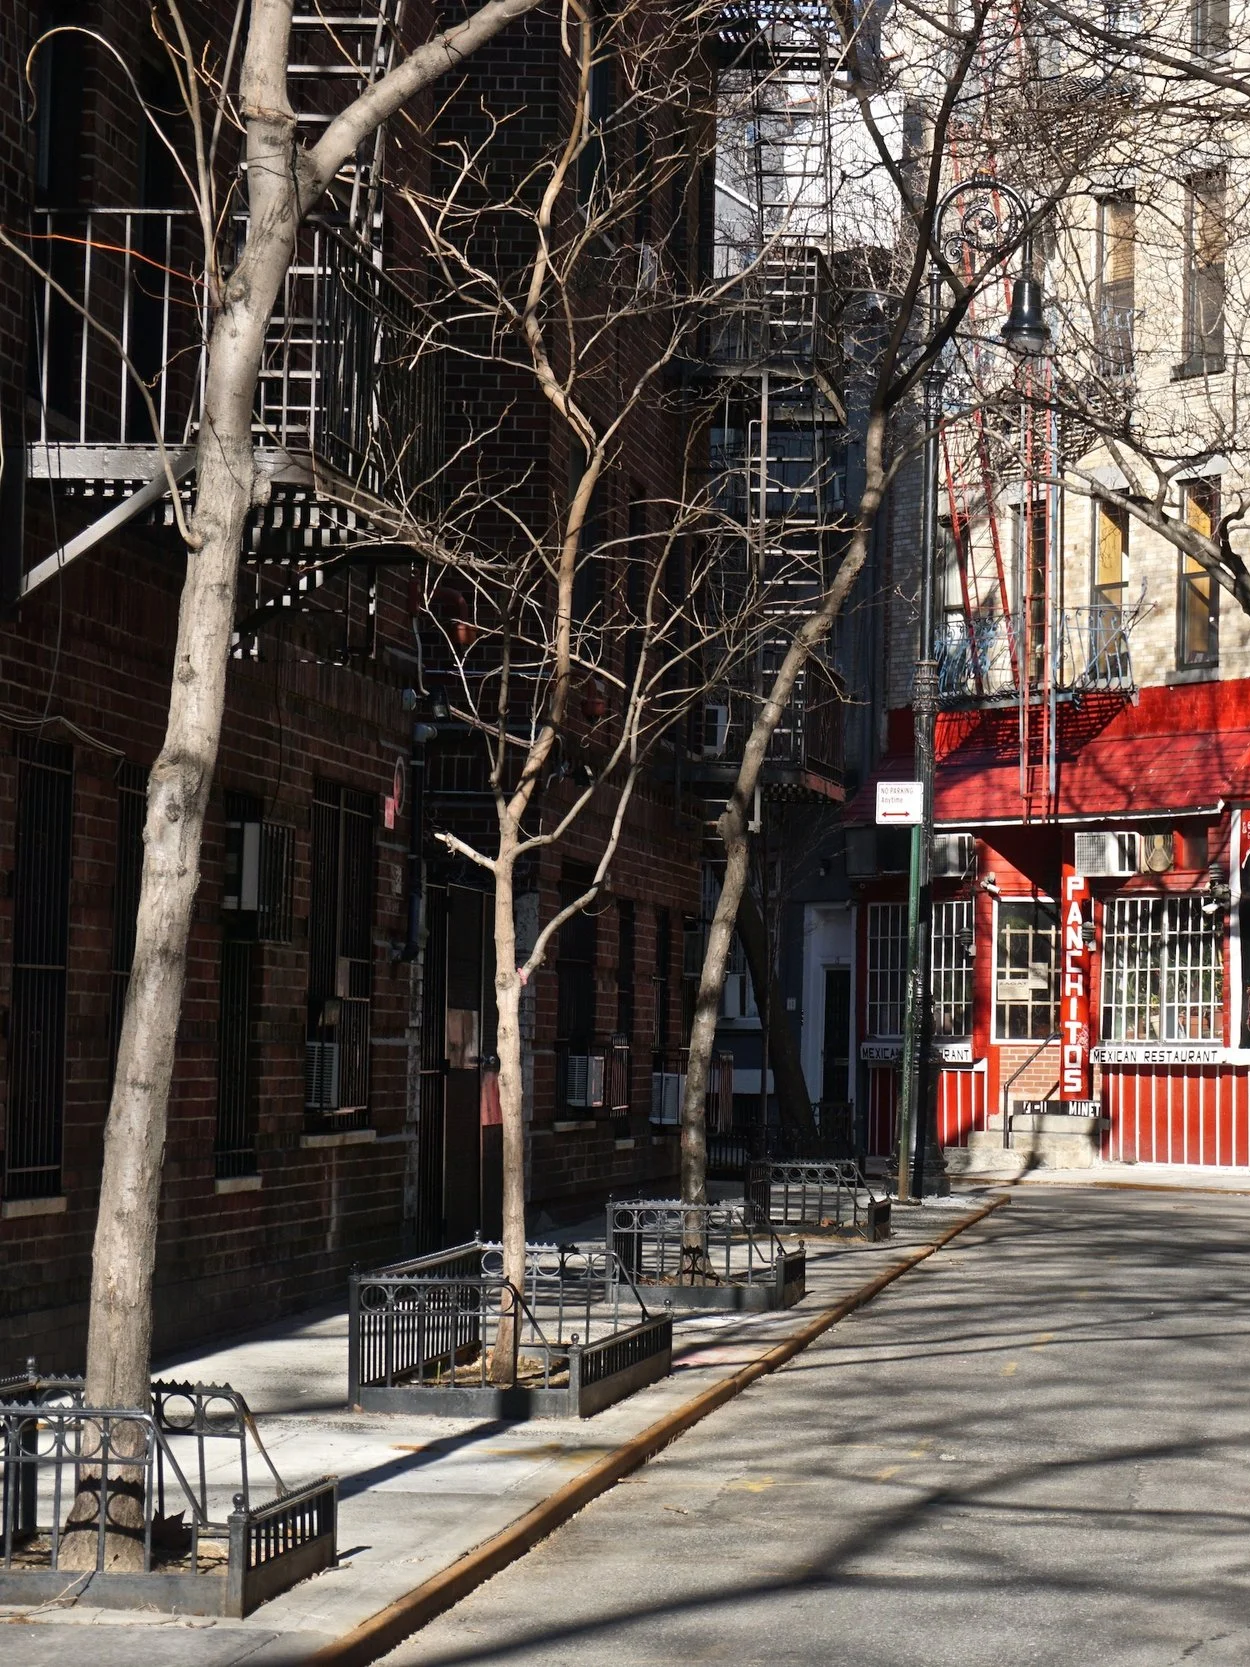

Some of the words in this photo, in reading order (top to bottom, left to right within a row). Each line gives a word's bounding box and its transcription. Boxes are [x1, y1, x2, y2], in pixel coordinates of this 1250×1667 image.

[1063, 876, 1085, 1093] PANCHITOS
[1093, 1049, 1137, 1062] MEXICAN
[1144, 1050, 1218, 1062] RESTAURANT
